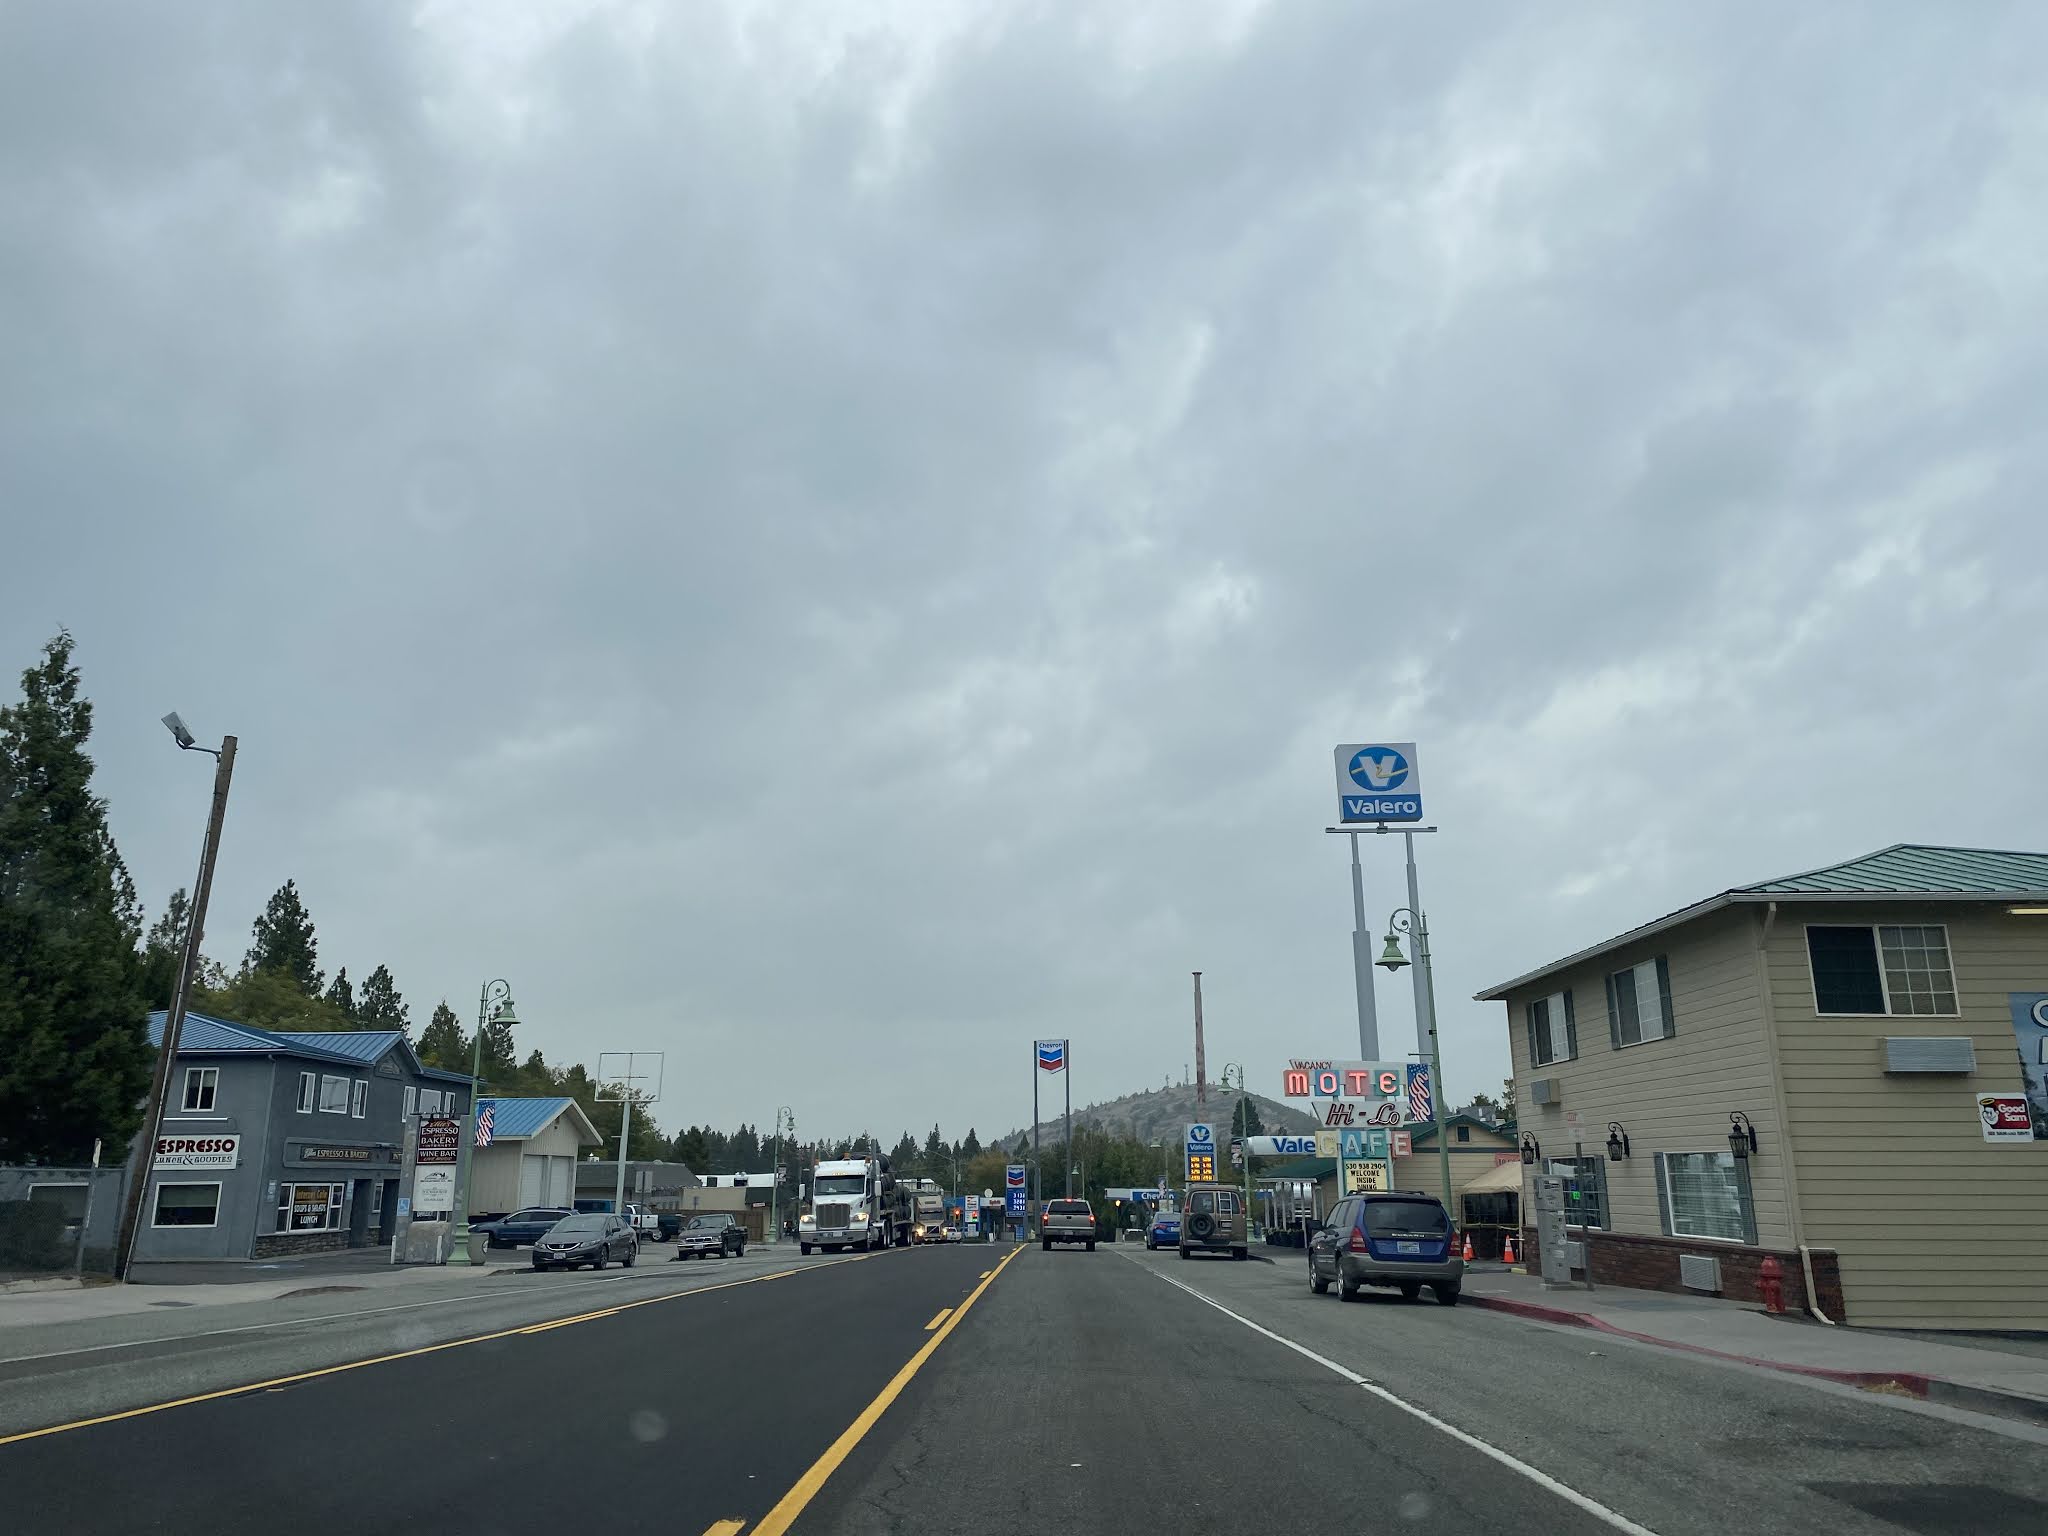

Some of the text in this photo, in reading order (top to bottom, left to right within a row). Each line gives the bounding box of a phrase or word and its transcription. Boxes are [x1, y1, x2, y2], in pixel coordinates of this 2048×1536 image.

[1347, 799, 1417, 814] Valero
[1294, 1061, 1332, 1070] VACANCY
[1288, 1072, 1400, 1094] MOTE
[1998, 1104, 2026, 1114] Good
[2004, 1112, 2027, 1122] Sam
[421, 1127, 459, 1135] ESPRESSO
[157, 1139, 236, 1154] ESPRESSO
[1272, 1138, 1316, 1153] Vale
[1320, 1133, 1410, 1156] CAFE
[317, 1150, 344, 1158] ESPRESSO
[182, 1154, 195, 1166] &
[300, 1215, 318, 1224] LUNCH
